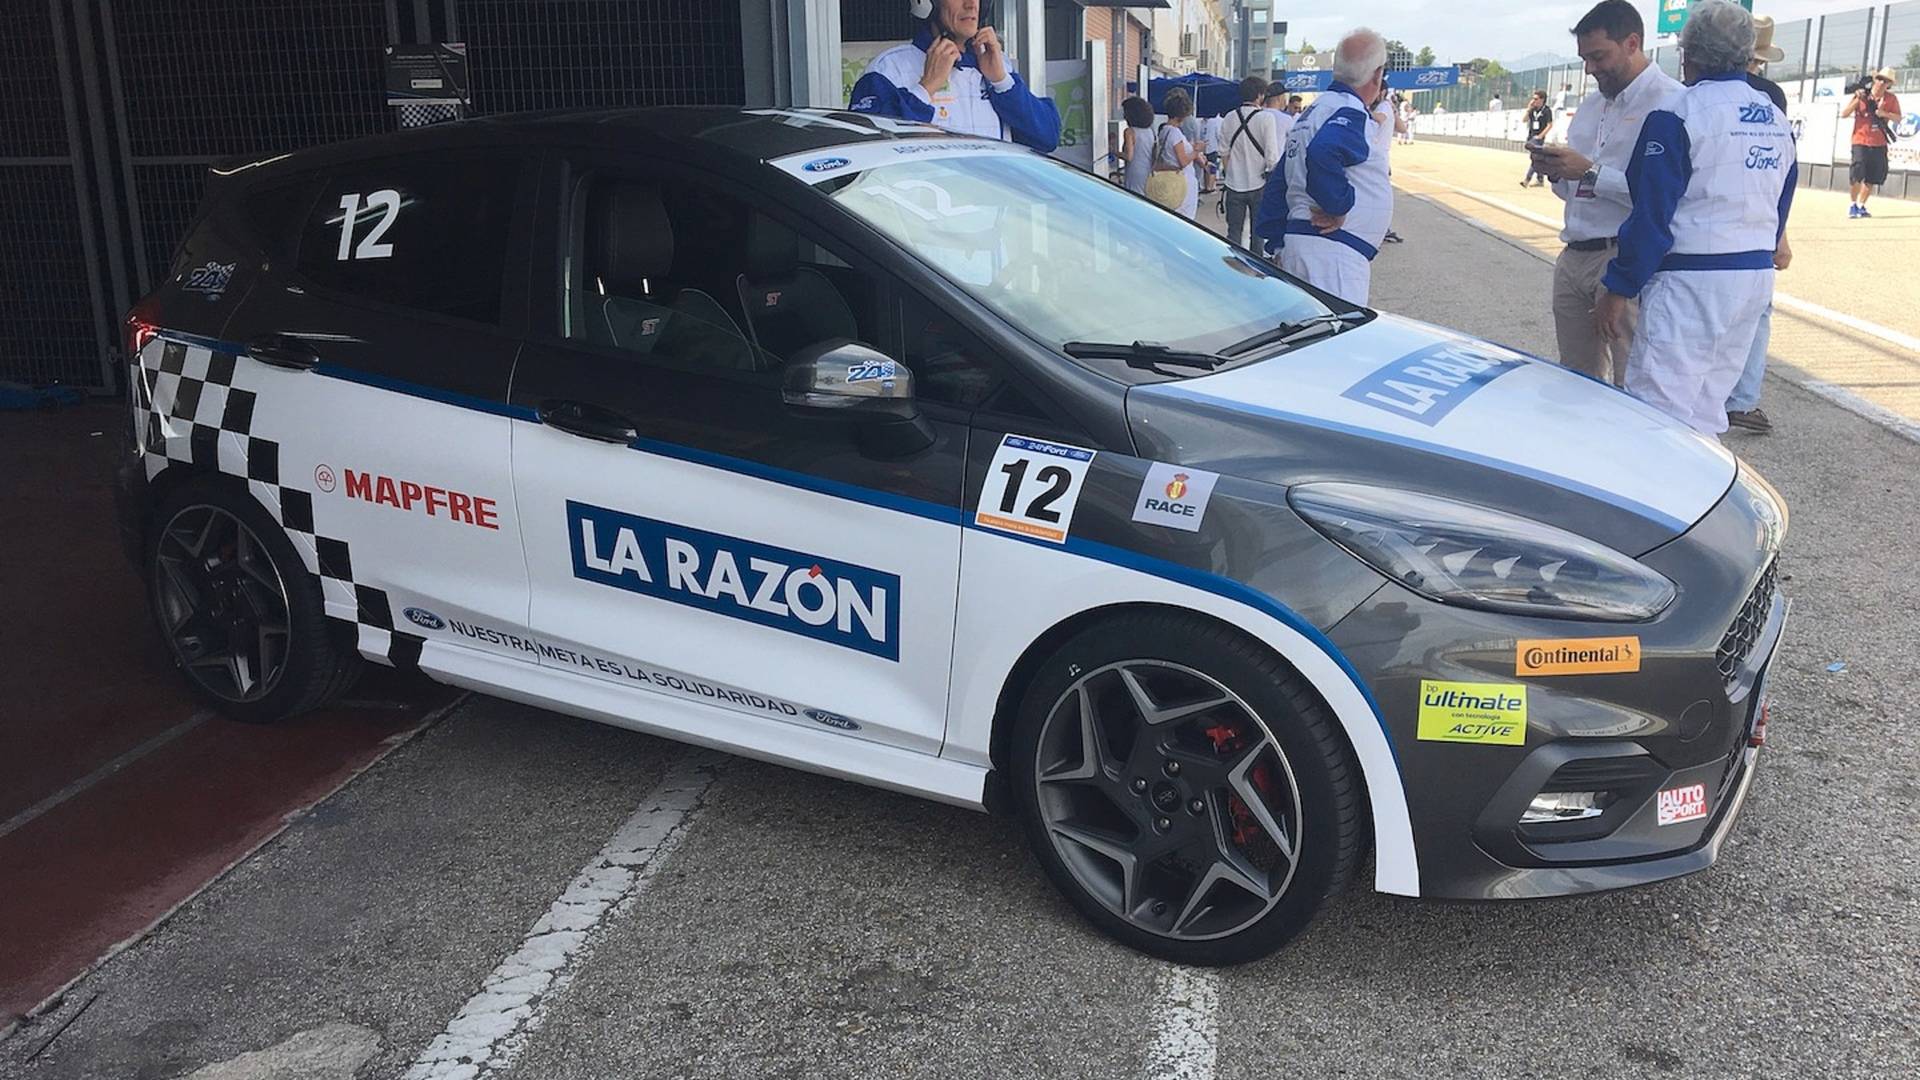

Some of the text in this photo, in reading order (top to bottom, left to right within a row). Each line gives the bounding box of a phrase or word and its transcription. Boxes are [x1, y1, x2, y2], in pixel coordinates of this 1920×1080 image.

[1745, 145, 1782, 169] Ford
[338, 190, 401, 260] 12
[1365, 379, 1449, 415] LA
[344, 469, 499, 530] MAPFRE
[1000, 458, 1072, 524] 12
[1145, 498, 1196, 517] RACE
[581, 517, 887, 643] LA RAZÓN
[448, 618, 799, 717] NUESTRA META ES LA SOLIDARIDAD
[1524, 645, 1619, 669] Continental
[1426, 684, 1438, 693] bp
[1425, 691, 1522, 711] ultimate
[1449, 723, 1515, 737] ACTIVE
[1661, 785, 1705, 808] AUTO
[1660, 800, 1705, 820] SPORT
